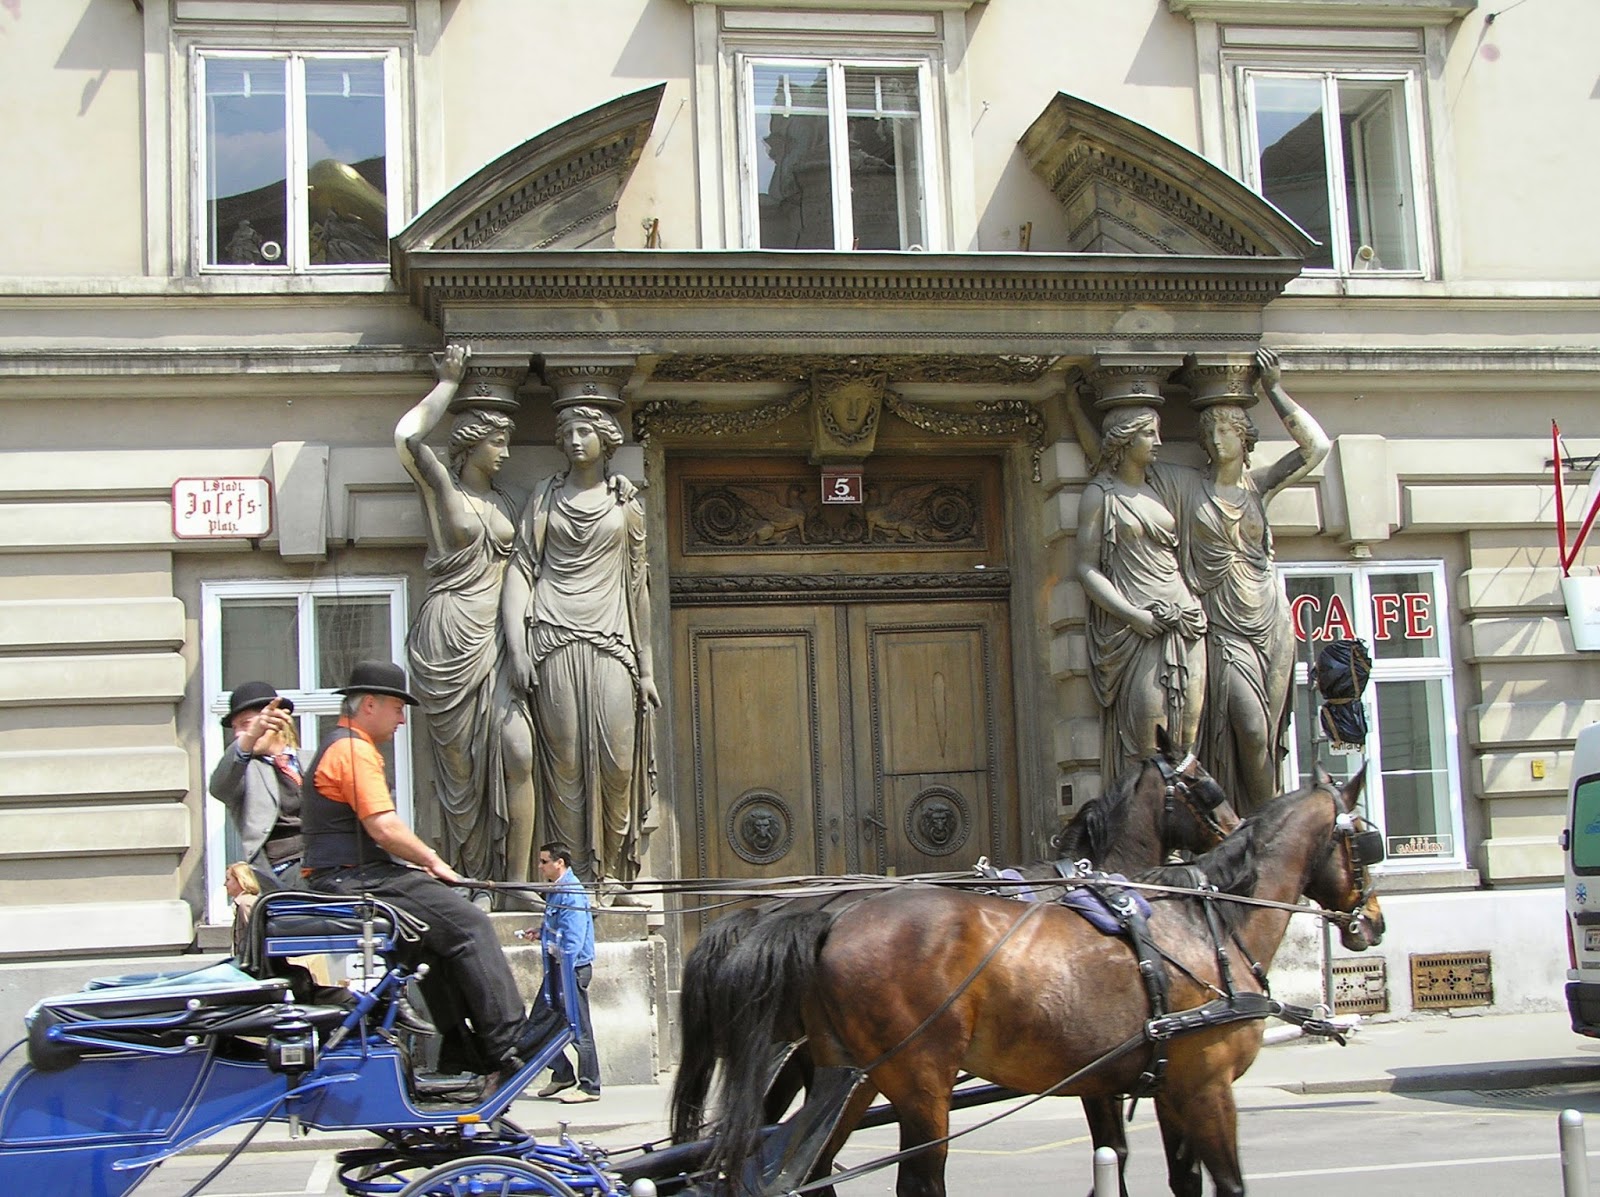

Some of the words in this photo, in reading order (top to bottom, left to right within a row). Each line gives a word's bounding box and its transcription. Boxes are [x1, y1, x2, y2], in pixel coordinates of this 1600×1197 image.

[834, 478, 850, 496] 5
[1290, 594, 1434, 642] CAFE
[1396, 842, 1444, 854] GALLERY
